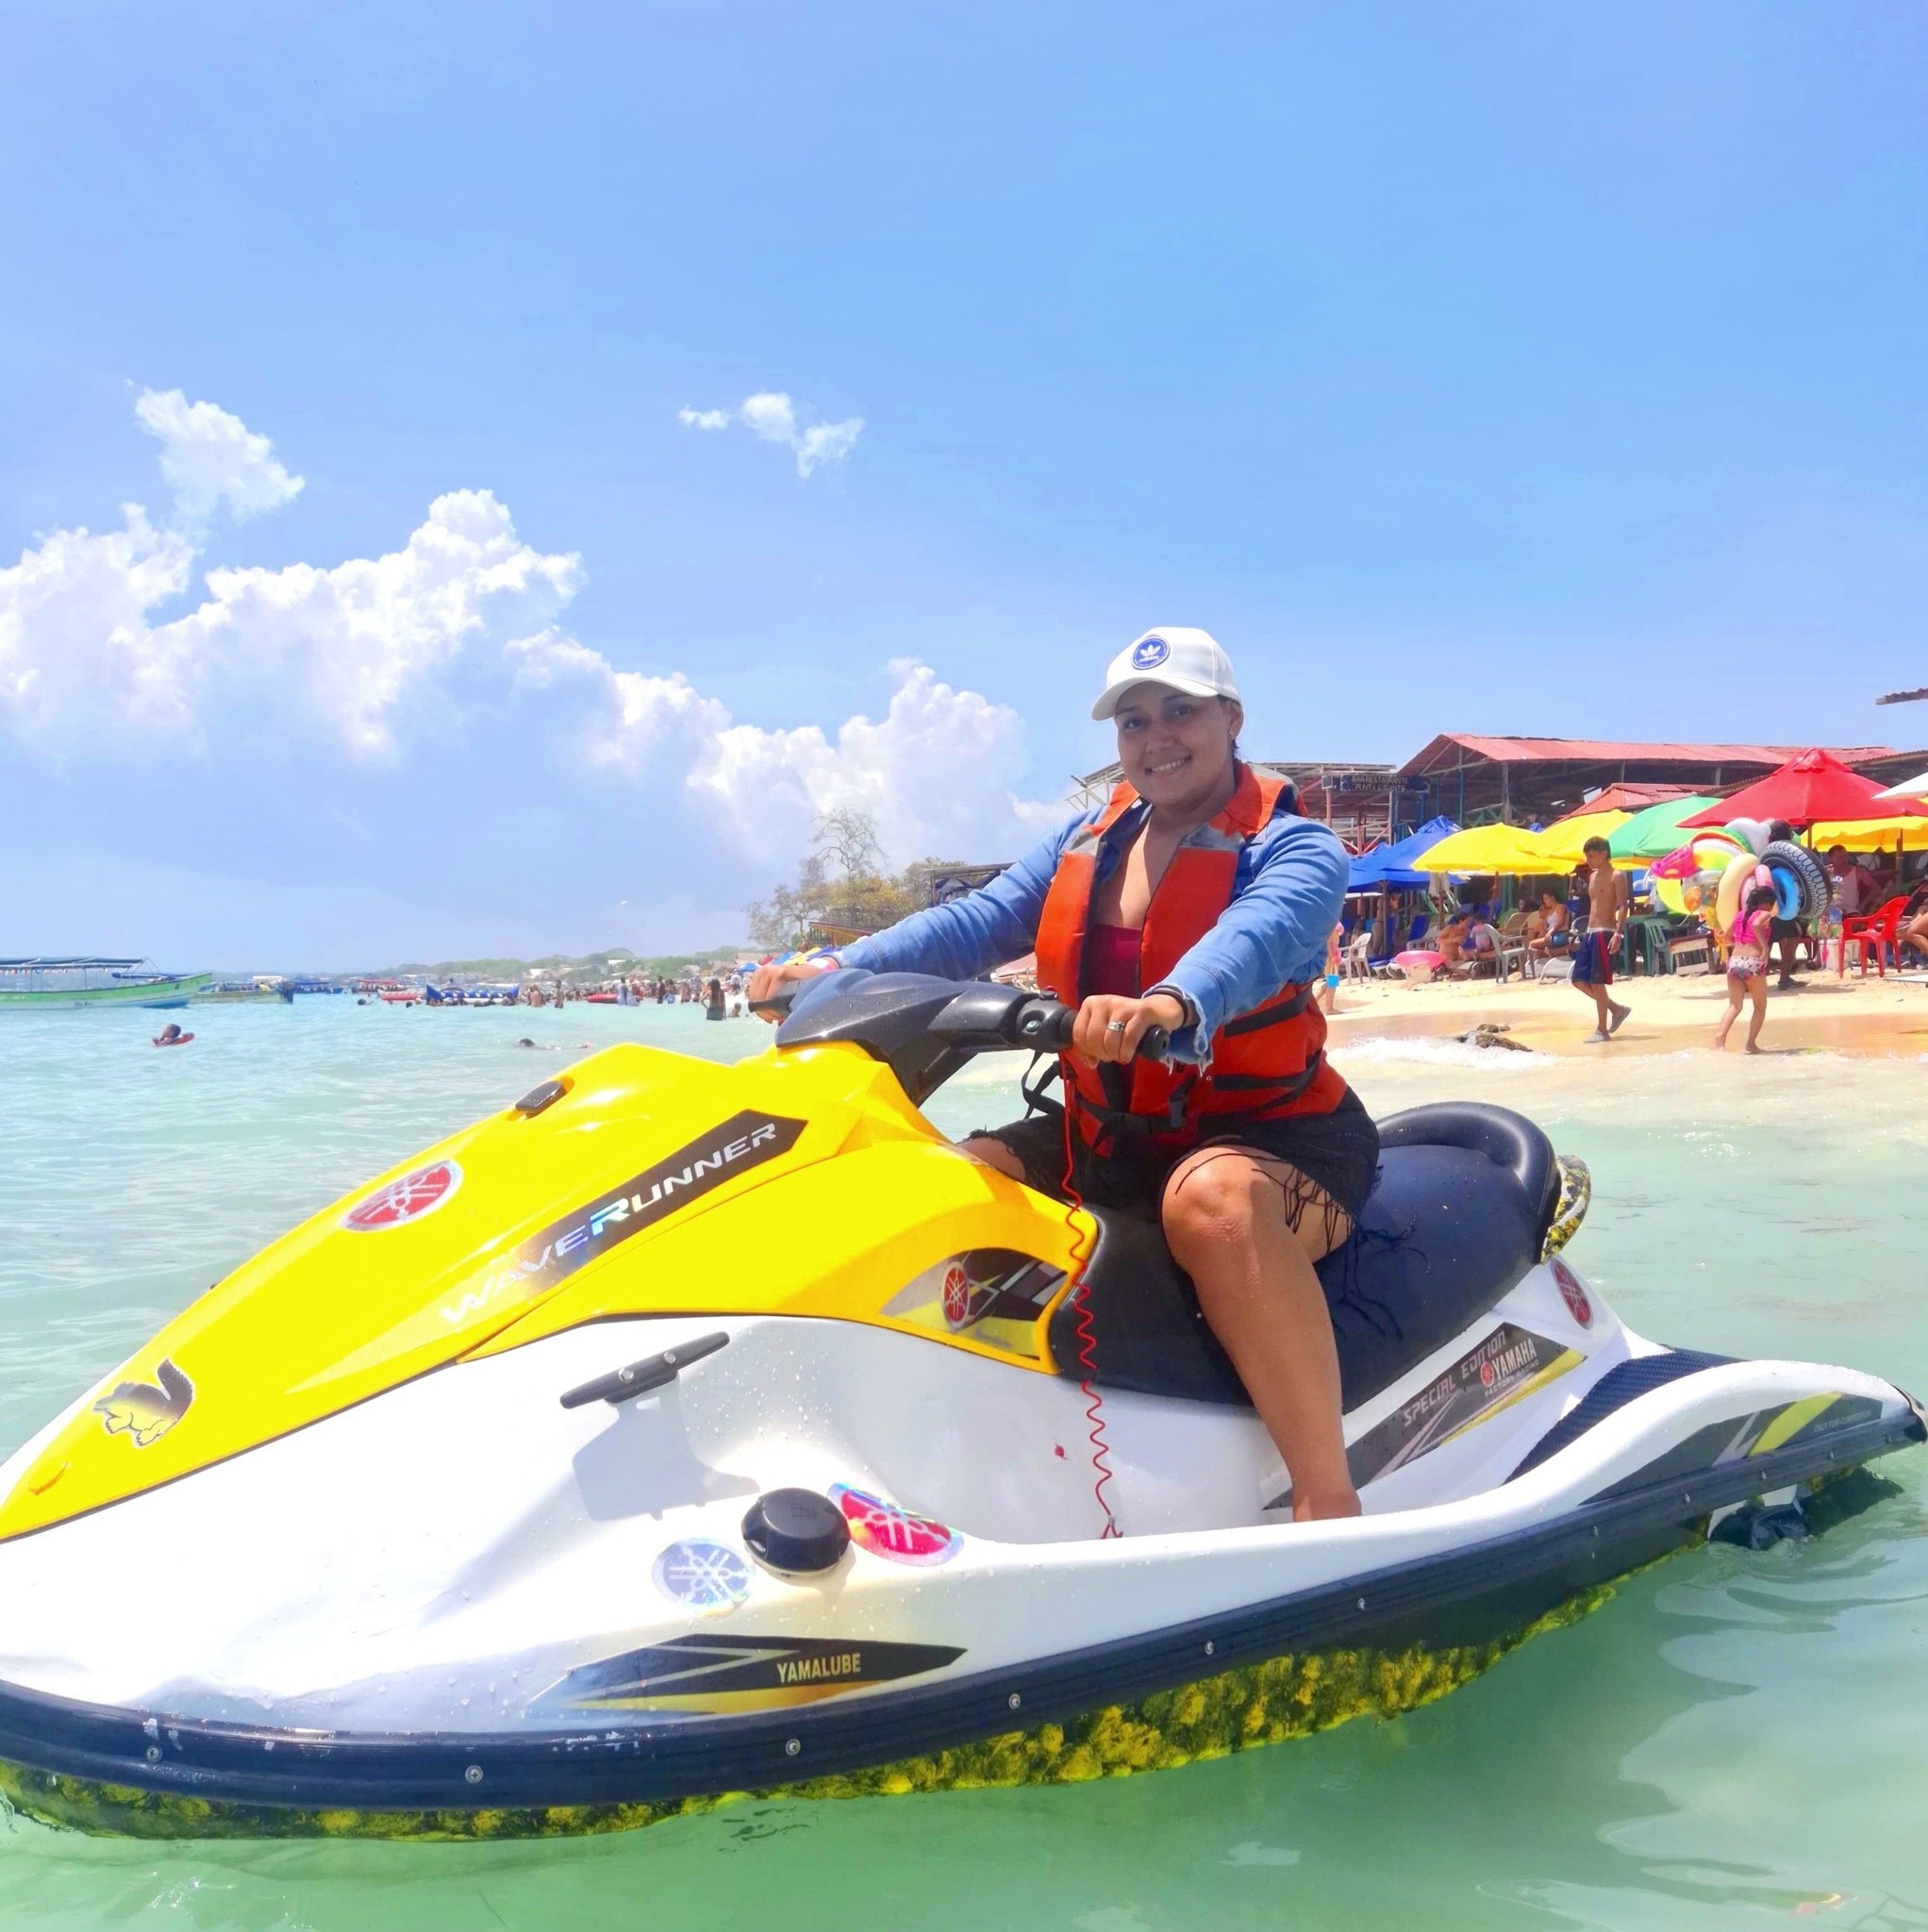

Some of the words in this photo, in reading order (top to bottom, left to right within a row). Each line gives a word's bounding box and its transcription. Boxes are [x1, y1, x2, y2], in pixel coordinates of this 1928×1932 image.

[1366, 775, 1408, 785] RESTAURANTE
[1492, 1338, 1537, 1380] YAMAHA
[1403, 1374, 1456, 1427] SPECIAL
[1461, 1330, 1506, 1379] EDITION
[1484, 1375, 1515, 1397] FACTORY
[777, 1653, 861, 1683] YAMALUBE
